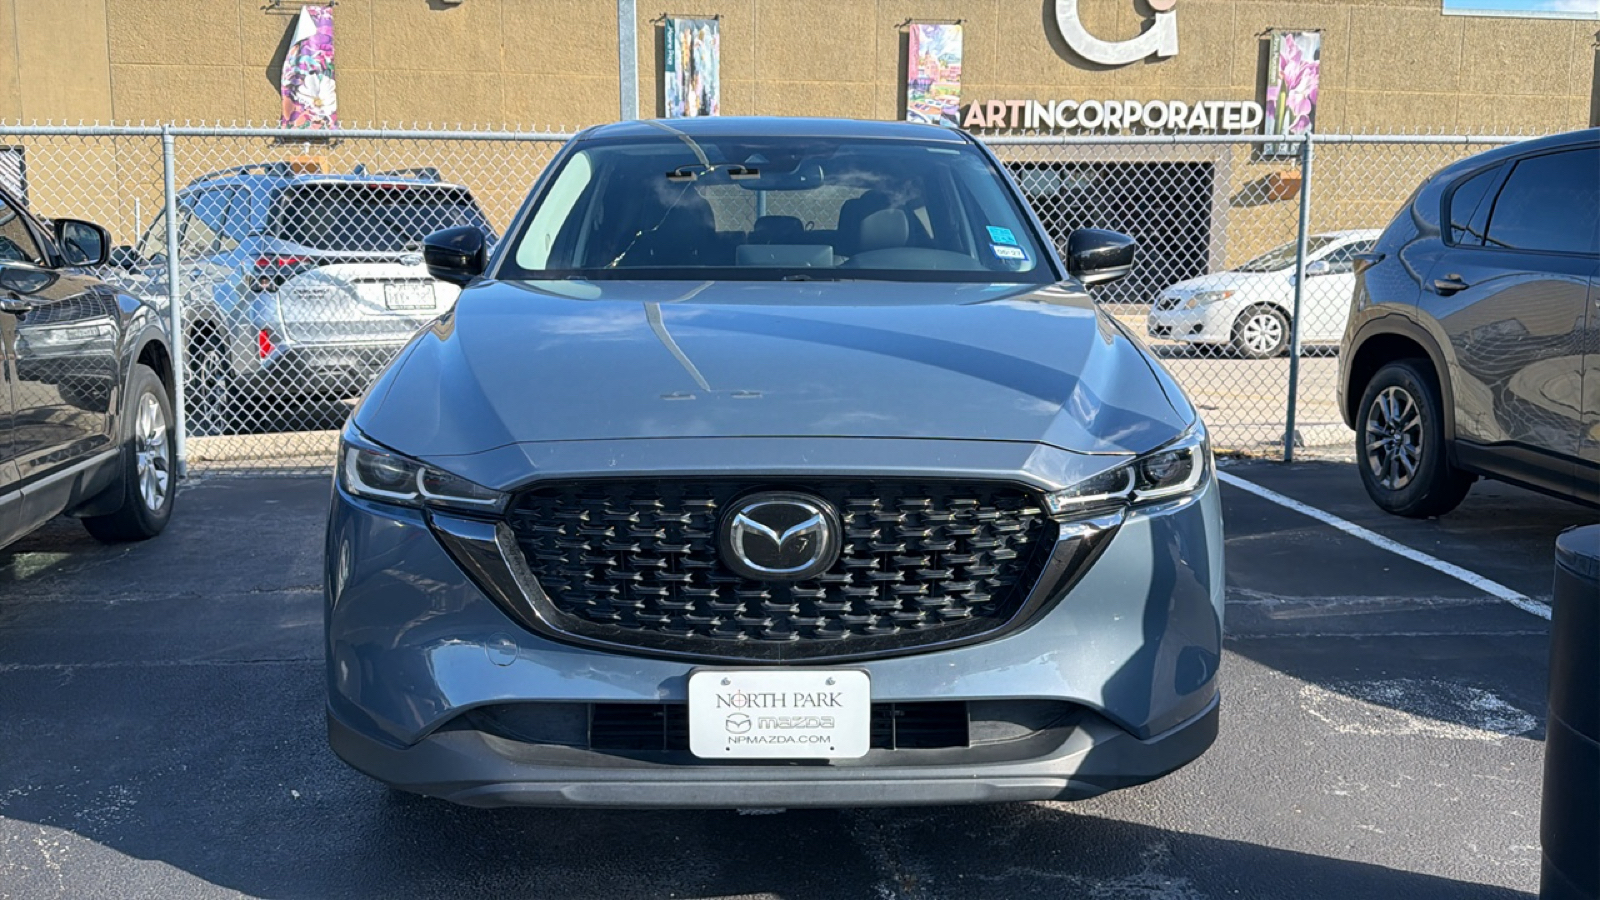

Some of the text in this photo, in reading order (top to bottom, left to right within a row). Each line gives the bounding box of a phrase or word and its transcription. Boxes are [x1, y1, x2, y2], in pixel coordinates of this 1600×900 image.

[716, 692, 843, 708] NORTH PARK
[758, 716, 835, 729] mazda
[728, 735, 831, 744] NPMAZDA.COM
